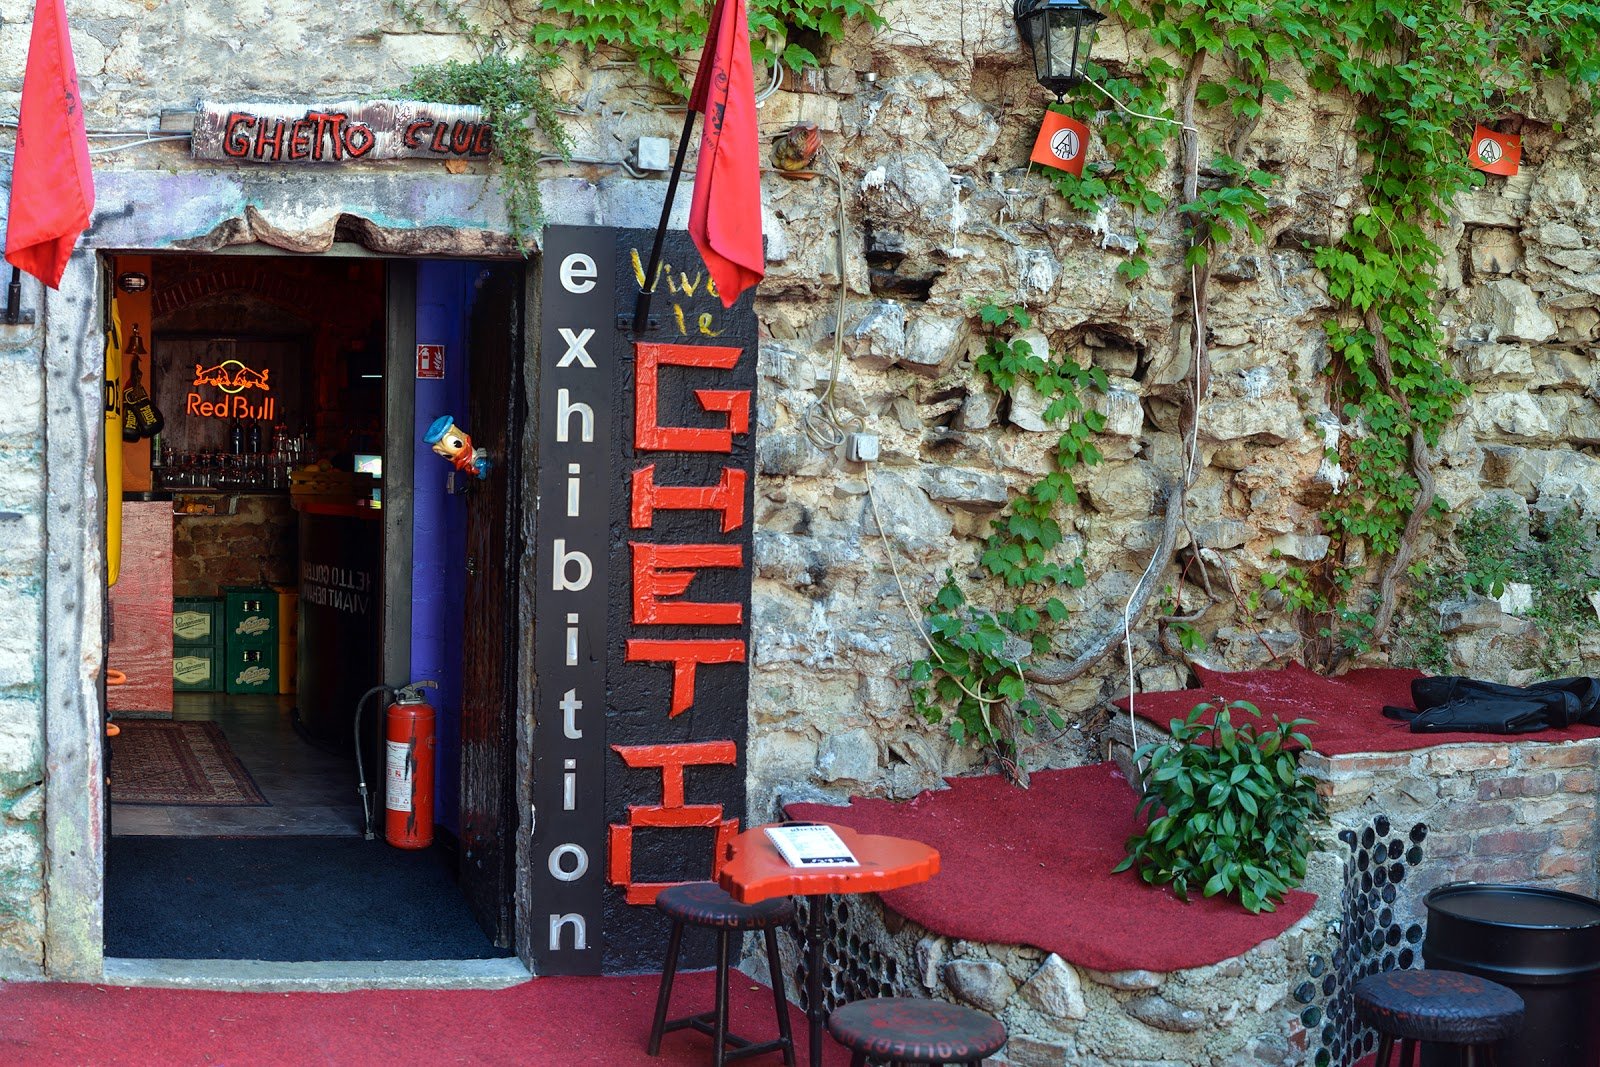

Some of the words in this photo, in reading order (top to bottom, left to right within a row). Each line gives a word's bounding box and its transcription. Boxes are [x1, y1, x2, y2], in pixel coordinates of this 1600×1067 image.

[223, 110, 375, 162] GHETTO
[404, 118, 493, 156] CLUB
[674, 303, 726, 337] le
[187, 393, 229, 418] Red
[233, 396, 275, 420] Bull
[547, 252, 598, 951] exhibition
[608, 341, 752, 906] GHETTO
